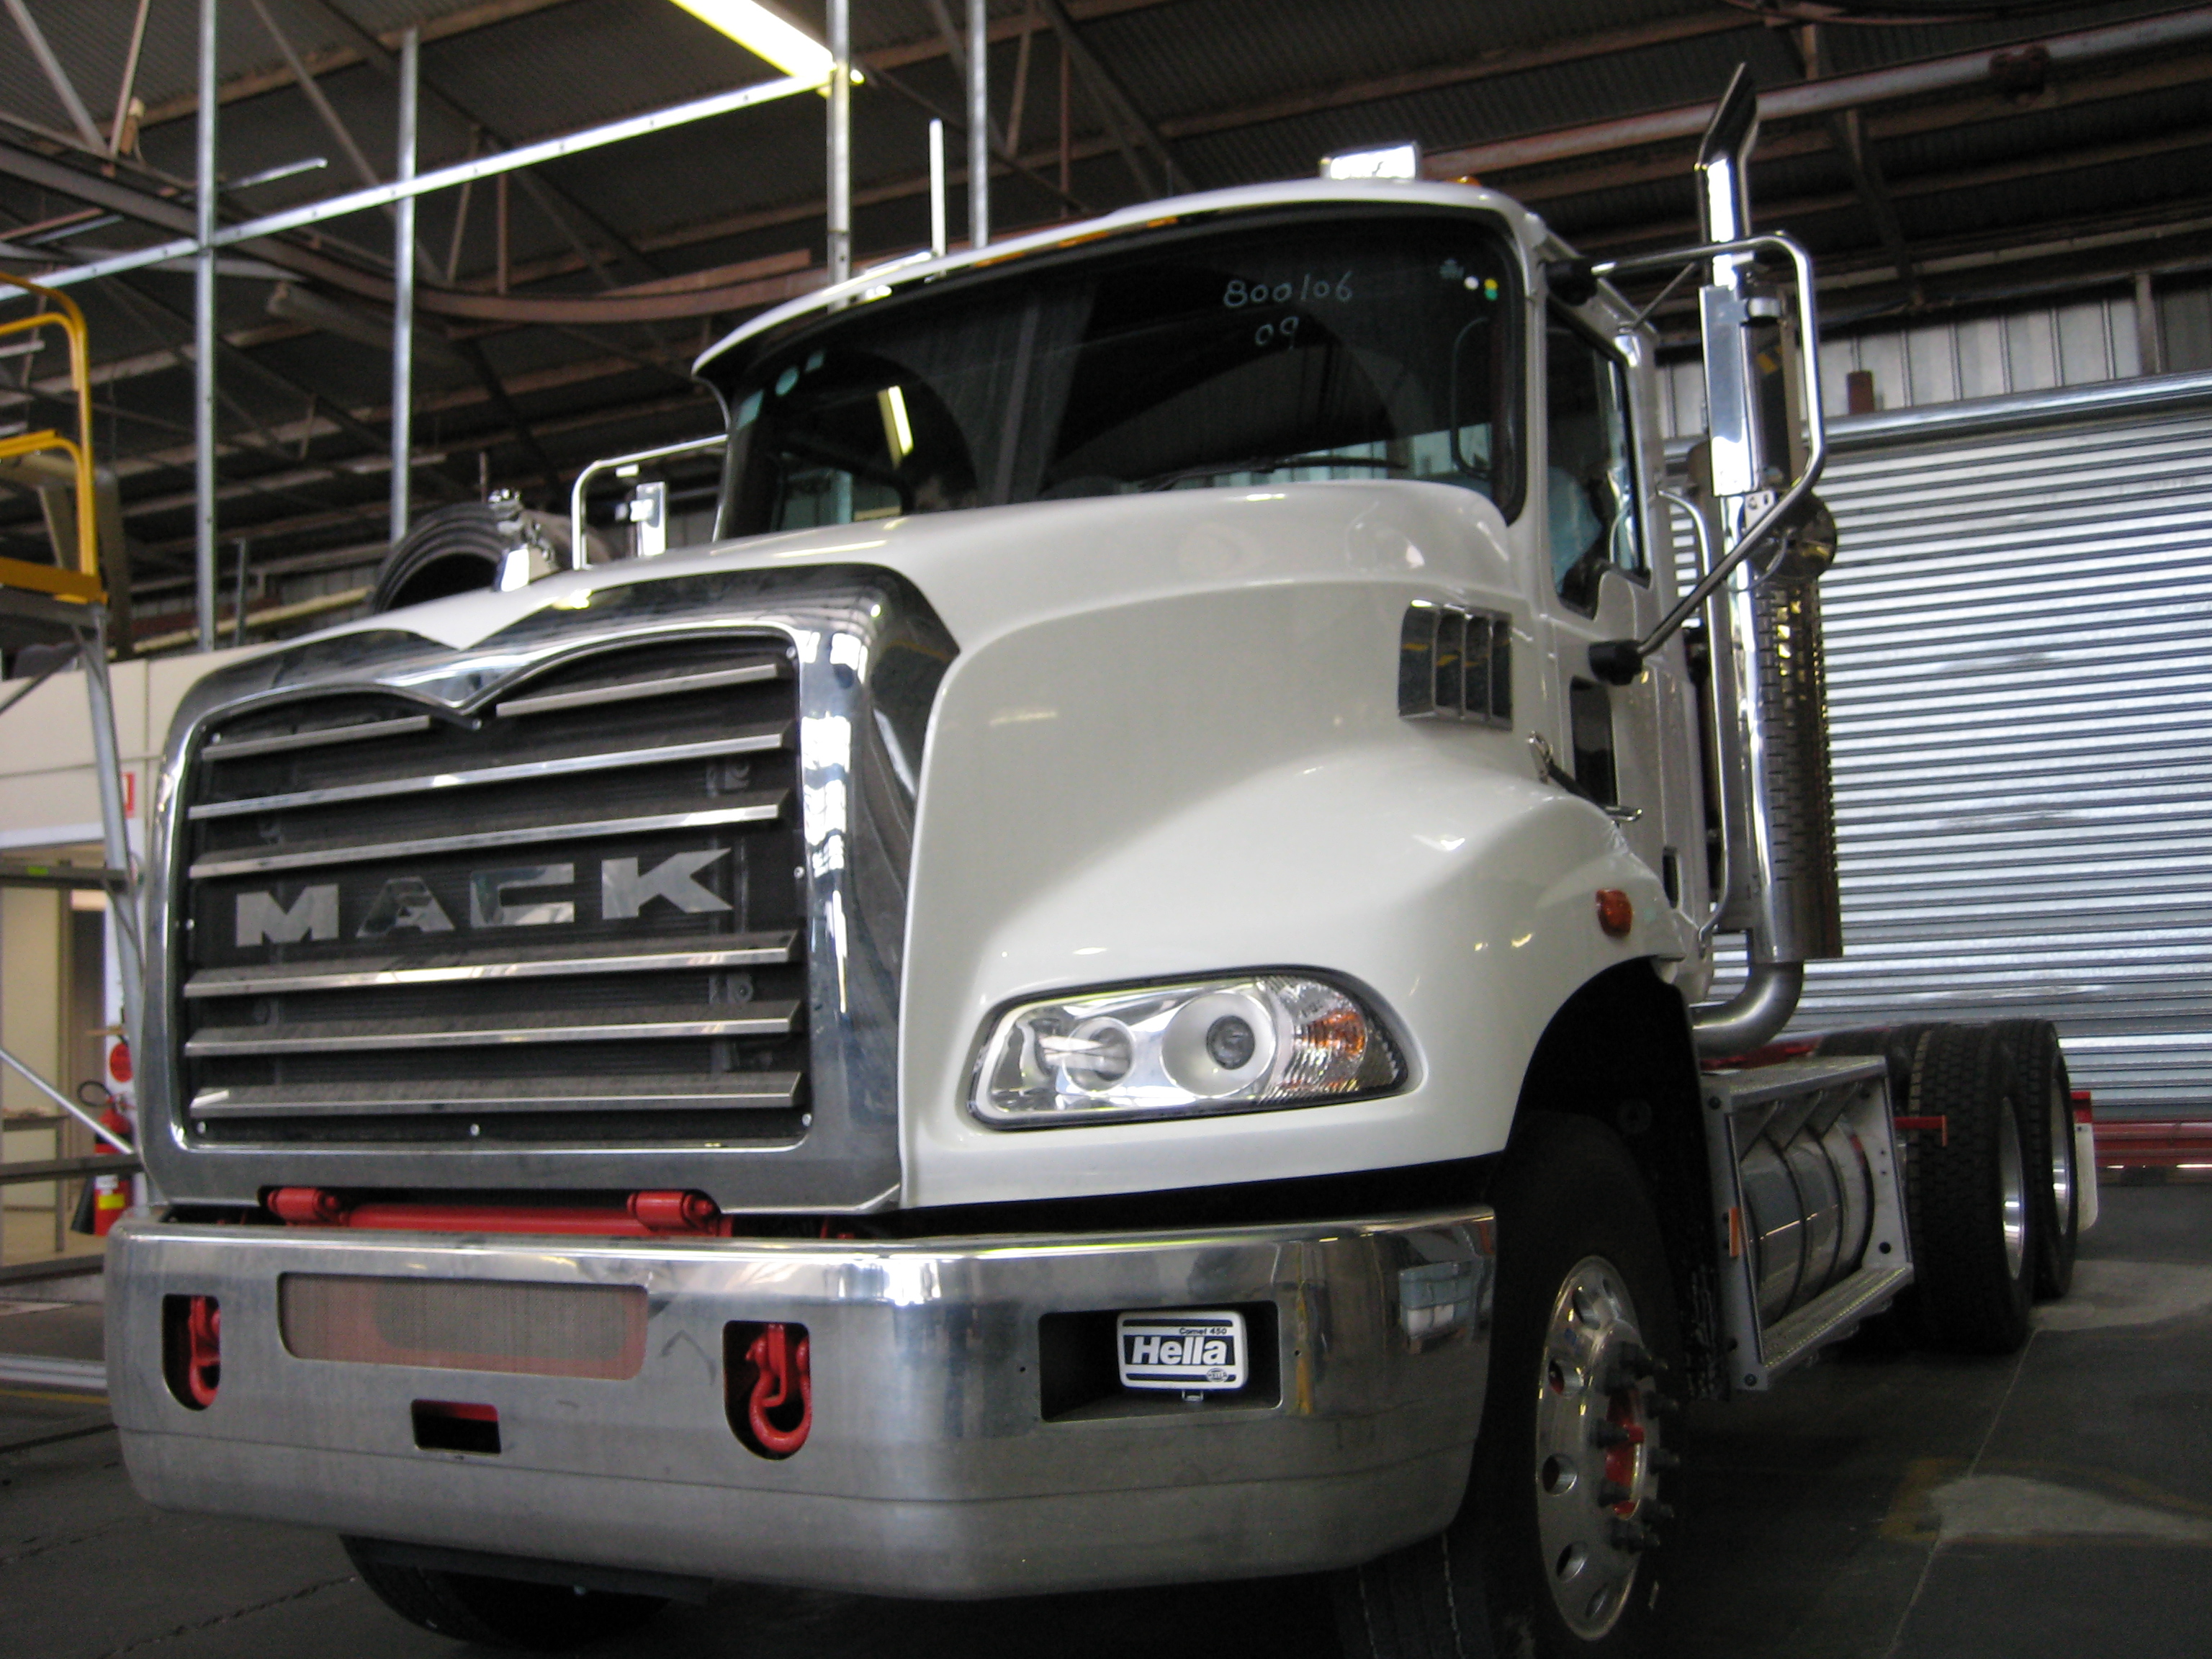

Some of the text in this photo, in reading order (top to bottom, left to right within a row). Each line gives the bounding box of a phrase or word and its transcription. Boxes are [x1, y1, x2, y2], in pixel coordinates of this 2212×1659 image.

[1224, 271, 1352, 307] 800106
[1254, 316, 1299, 350] 09
[235, 848, 732, 947] MACK
[1132, 1336, 1227, 1364] Hella
